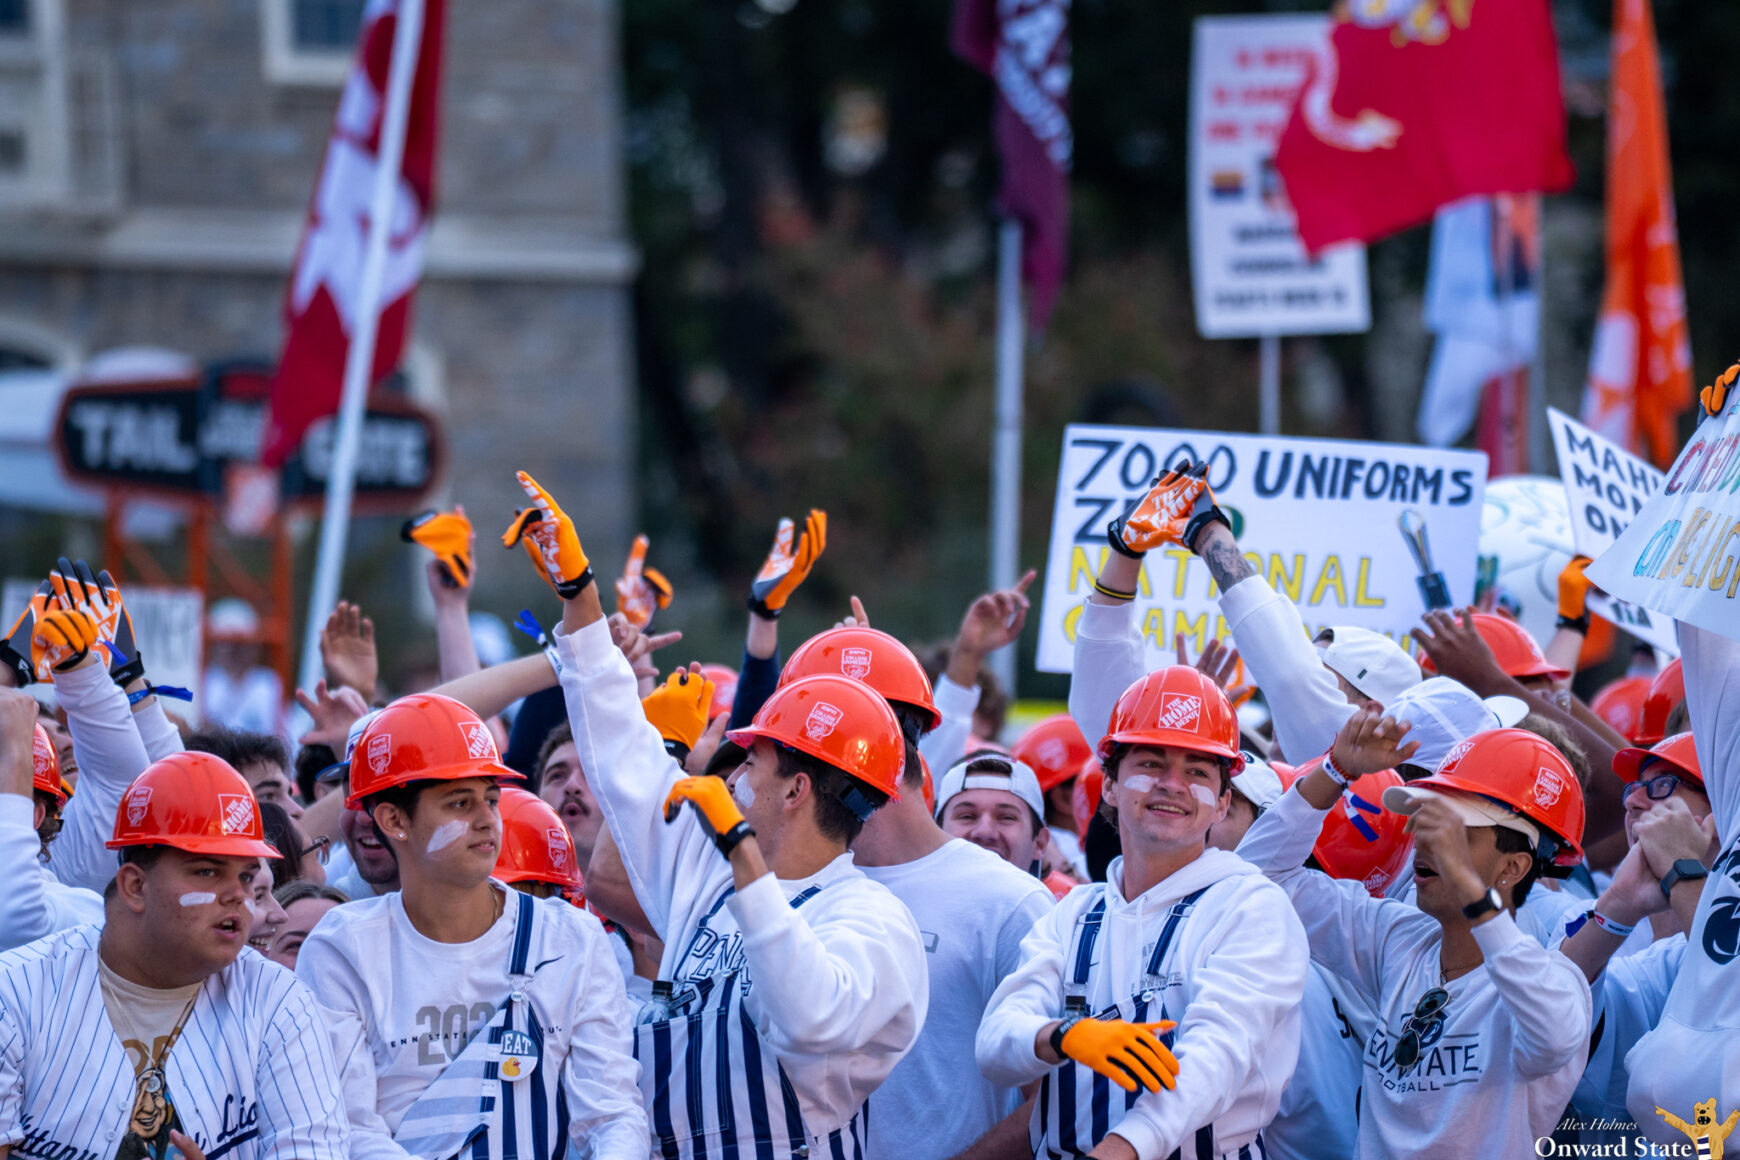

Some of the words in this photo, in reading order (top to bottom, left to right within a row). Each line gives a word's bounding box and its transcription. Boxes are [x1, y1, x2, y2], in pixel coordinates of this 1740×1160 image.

[1254, 450, 1474, 505] UNIFORMS
[1068, 546, 1385, 607] NTNAL
[1160, 696, 1200, 728] HOME
[1165, 697, 1182, 710] THE
[1174, 709, 1200, 729] DEPOT
[224, 796, 253, 832] HOME
[226, 799, 240, 813] THE
[428, 1032, 467, 1041] STATE
